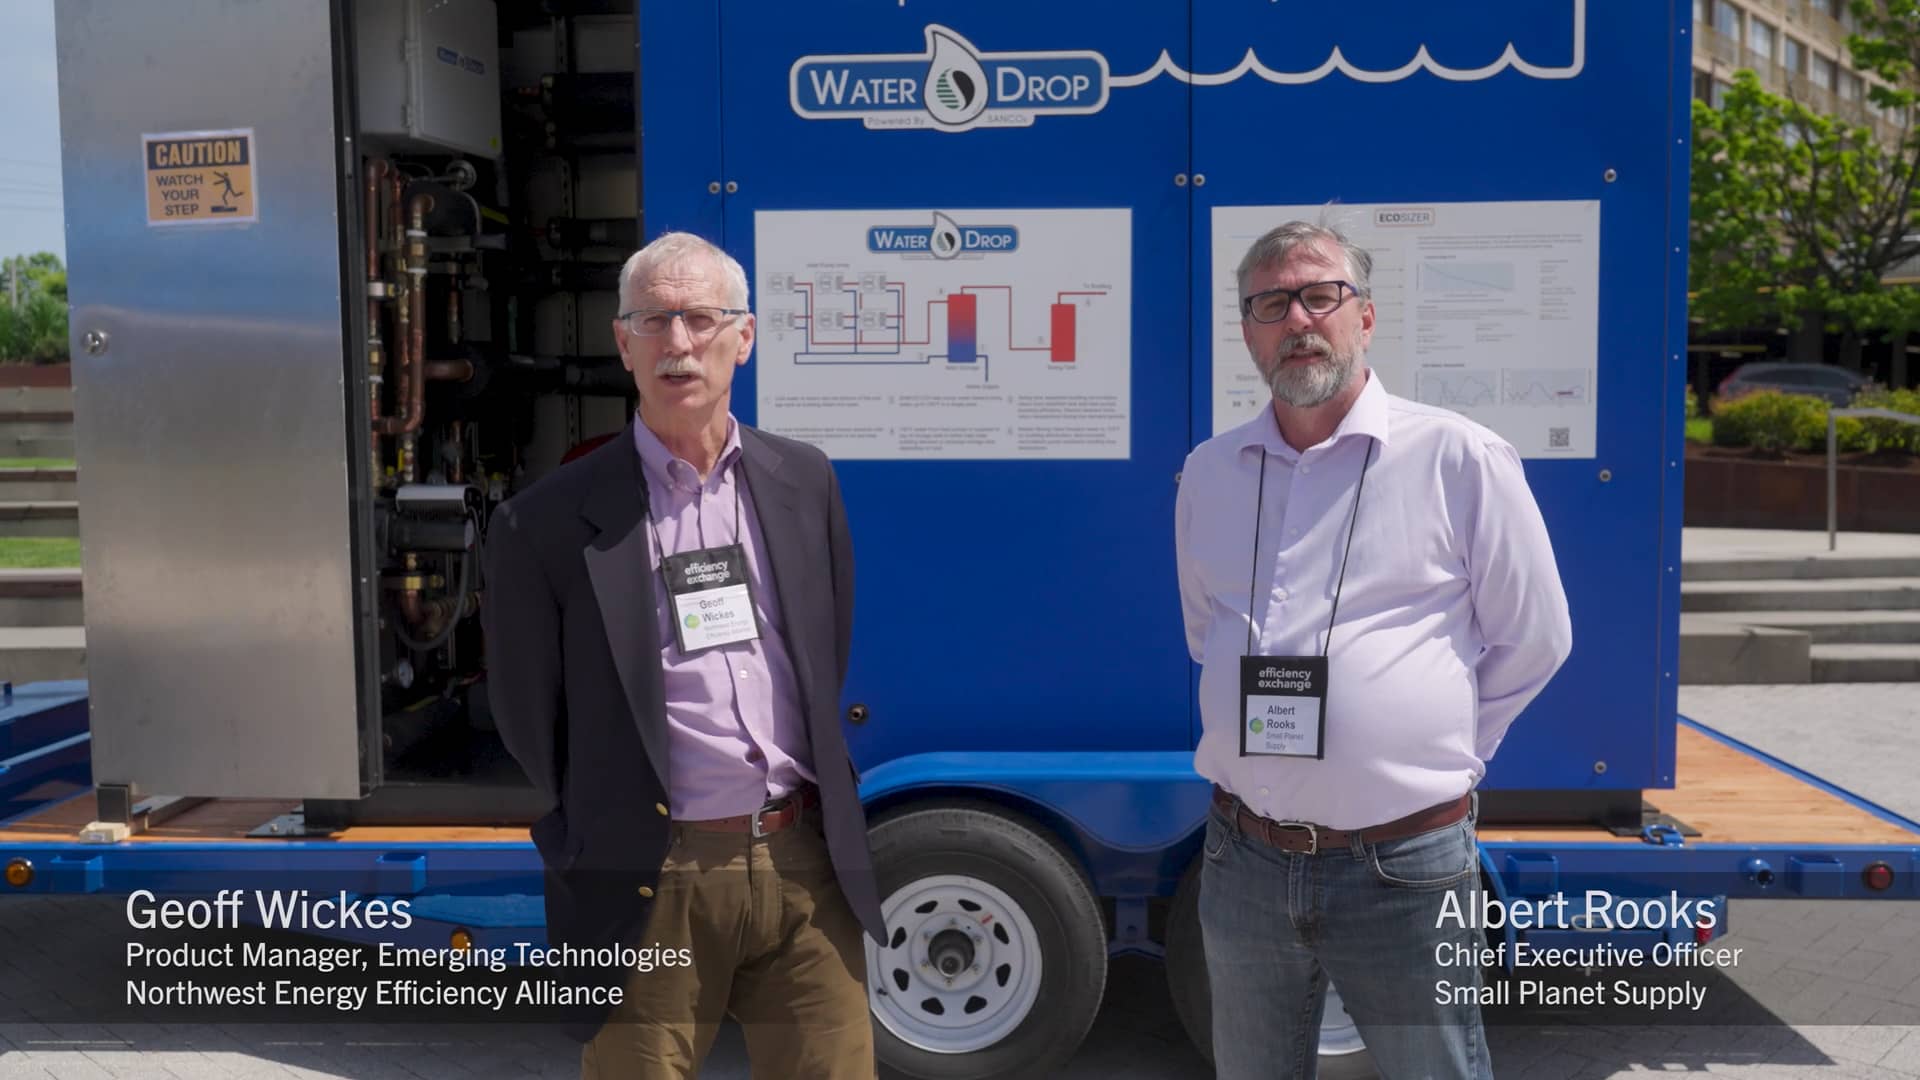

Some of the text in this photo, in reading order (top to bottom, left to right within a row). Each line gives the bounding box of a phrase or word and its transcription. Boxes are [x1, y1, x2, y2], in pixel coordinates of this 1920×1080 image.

[809, 66, 1090, 105] WATER DROP
[155, 139, 241, 167] CAUTION
[156, 174, 203, 187] WATCH
[161, 188, 200, 201] YOUR
[165, 203, 199, 216] STEP
[1379, 212, 1430, 223] ECOSIZER
[874, 229, 1012, 249] WATER DROP
[684, 561, 728, 575] efficiency
[686, 570, 731, 585] exchange
[702, 610, 735, 622] Wickes
[1258, 667, 1312, 681] efficiency
[1258, 678, 1312, 692] exchange
[1267, 704, 1295, 715] Albert
[1266, 718, 1296, 729] Rooks
